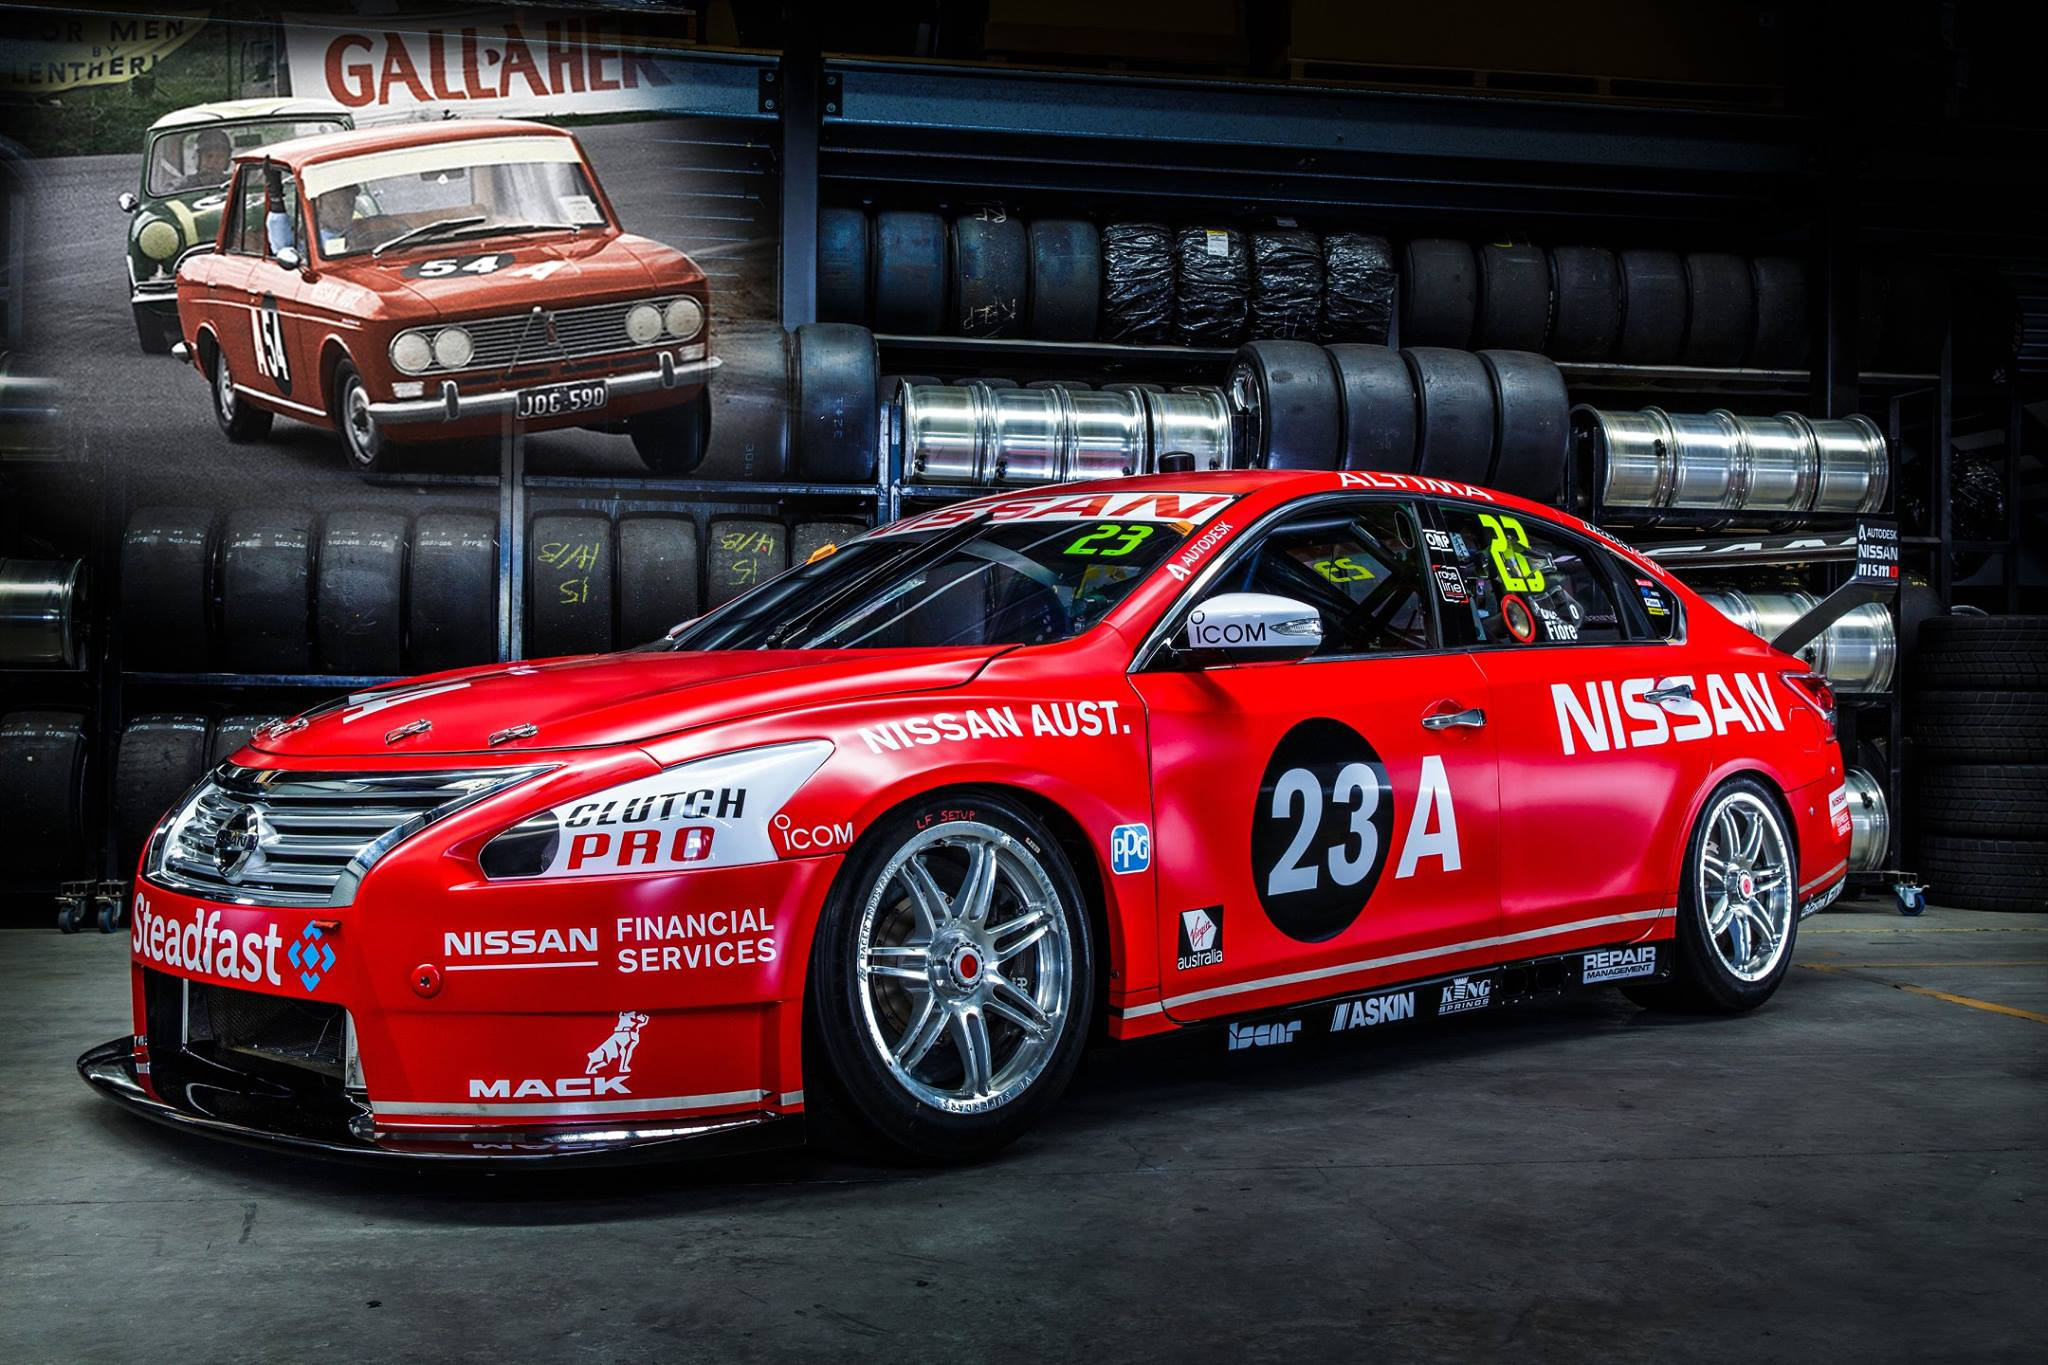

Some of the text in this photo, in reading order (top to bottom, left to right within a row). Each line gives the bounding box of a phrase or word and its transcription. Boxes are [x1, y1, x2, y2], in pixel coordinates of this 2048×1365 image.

[23, 20, 185, 42] OR MEN
[92, 46, 119, 57] BY
[419, 255, 499, 276] 54
[570, 387, 604, 410] 590
[1337, 472, 1494, 499] ALTIMA
[1063, 525, 1154, 555] 23
[1183, 521, 1233, 566] AUTODESK
[1426, 533, 1450, 548] OMP
[1867, 528, 1897, 540] AUTODESK
[1859, 544, 1898, 560] NISSAN
[1859, 564, 1898, 577] nismo
[1545, 621, 1577, 640] Fiore
[1551, 673, 1785, 755] NISSAN
[857, 701, 1131, 753] NISSAN AUST.
[565, 788, 746, 827] CLUTCH
[916, 810, 976, 829] LF SETUP
[1268, 755, 1461, 896] 23 A
[567, 827, 715, 869] PRO
[1114, 829, 1148, 867] PPG
[617, 907, 775, 942] FINANCIAL
[133, 892, 282, 985] Steadfast
[444, 928, 598, 956] NISSAN
[861, 923, 871, 960] RACER
[618, 938, 777, 973] SERVICES
[1178, 949, 1223, 970] australia
[1584, 947, 1656, 970] REPAIR
[1587, 964, 1651, 979] MANAGEMENT
[1350, 992, 1415, 1029] ASKIN
[1439, 998, 1489, 1013] SPRINGS
[469, 1075, 632, 1098] MACK
